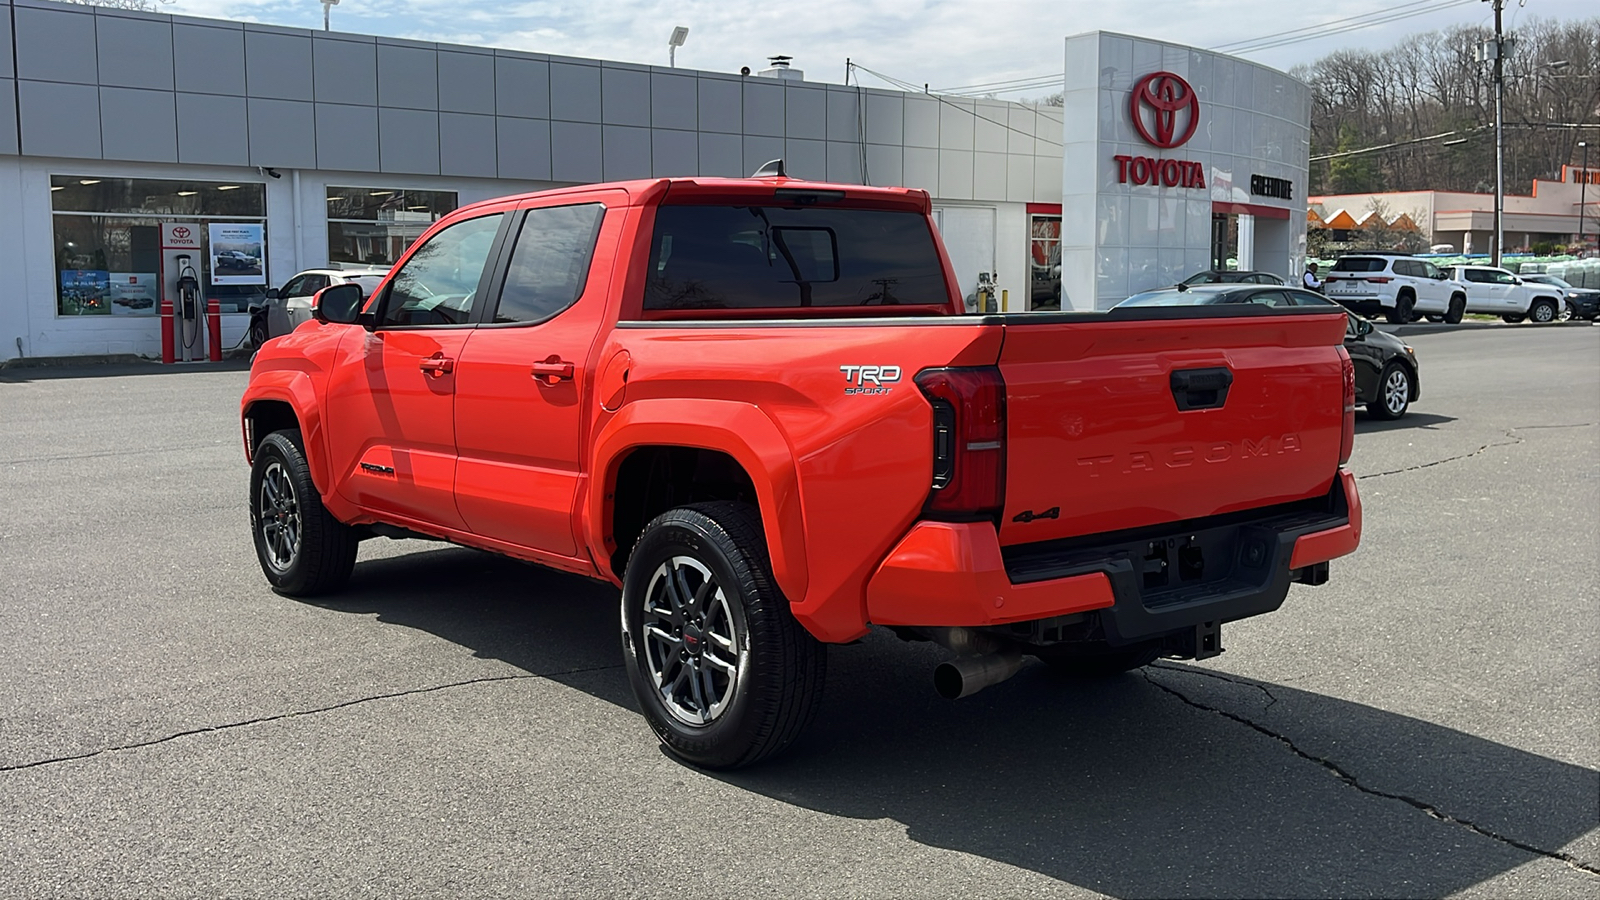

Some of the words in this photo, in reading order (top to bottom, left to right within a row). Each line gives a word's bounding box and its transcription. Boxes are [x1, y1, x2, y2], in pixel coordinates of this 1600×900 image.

[1114, 155, 1206, 189] TOYOTA
[840, 365, 901, 386] TRD
[844, 387, 893, 396] SPORT
[1077, 432, 1301, 478] TACOMA
